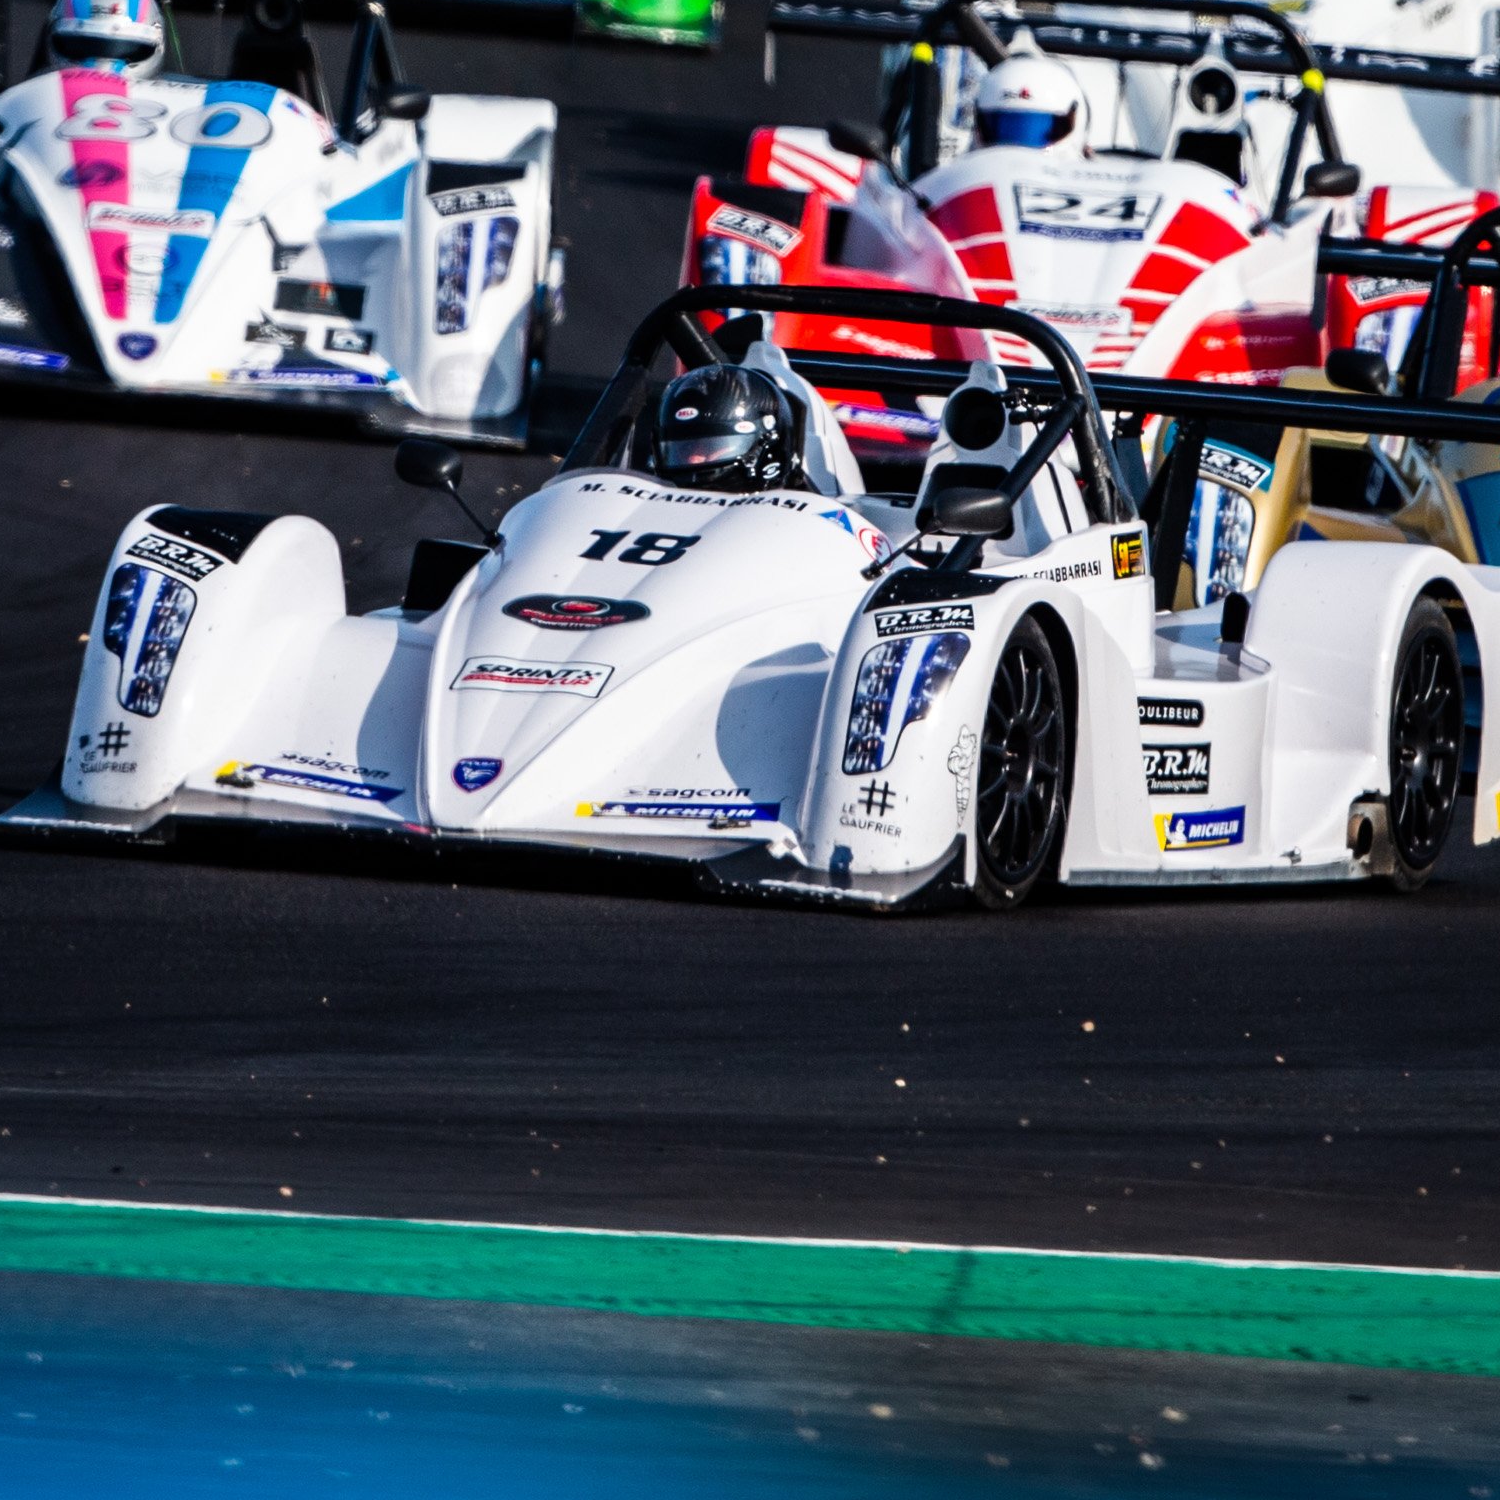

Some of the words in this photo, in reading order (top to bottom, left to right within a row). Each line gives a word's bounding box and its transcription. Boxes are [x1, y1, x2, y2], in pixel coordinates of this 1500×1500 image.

[55, 93, 273, 149] 80
[1023, 191, 1146, 220] 24
[579, 530, 702, 566] 18
[878, 604, 973, 627] B.R.M
[296, 756, 390, 780] sagcom
[647, 787, 751, 799] sagcom
[634, 806, 757, 818] MICHELIN
[842, 802, 856, 815] LE
[839, 816, 902, 838] GAUFRIER
[1188, 820, 1240, 838] MICHELIN
